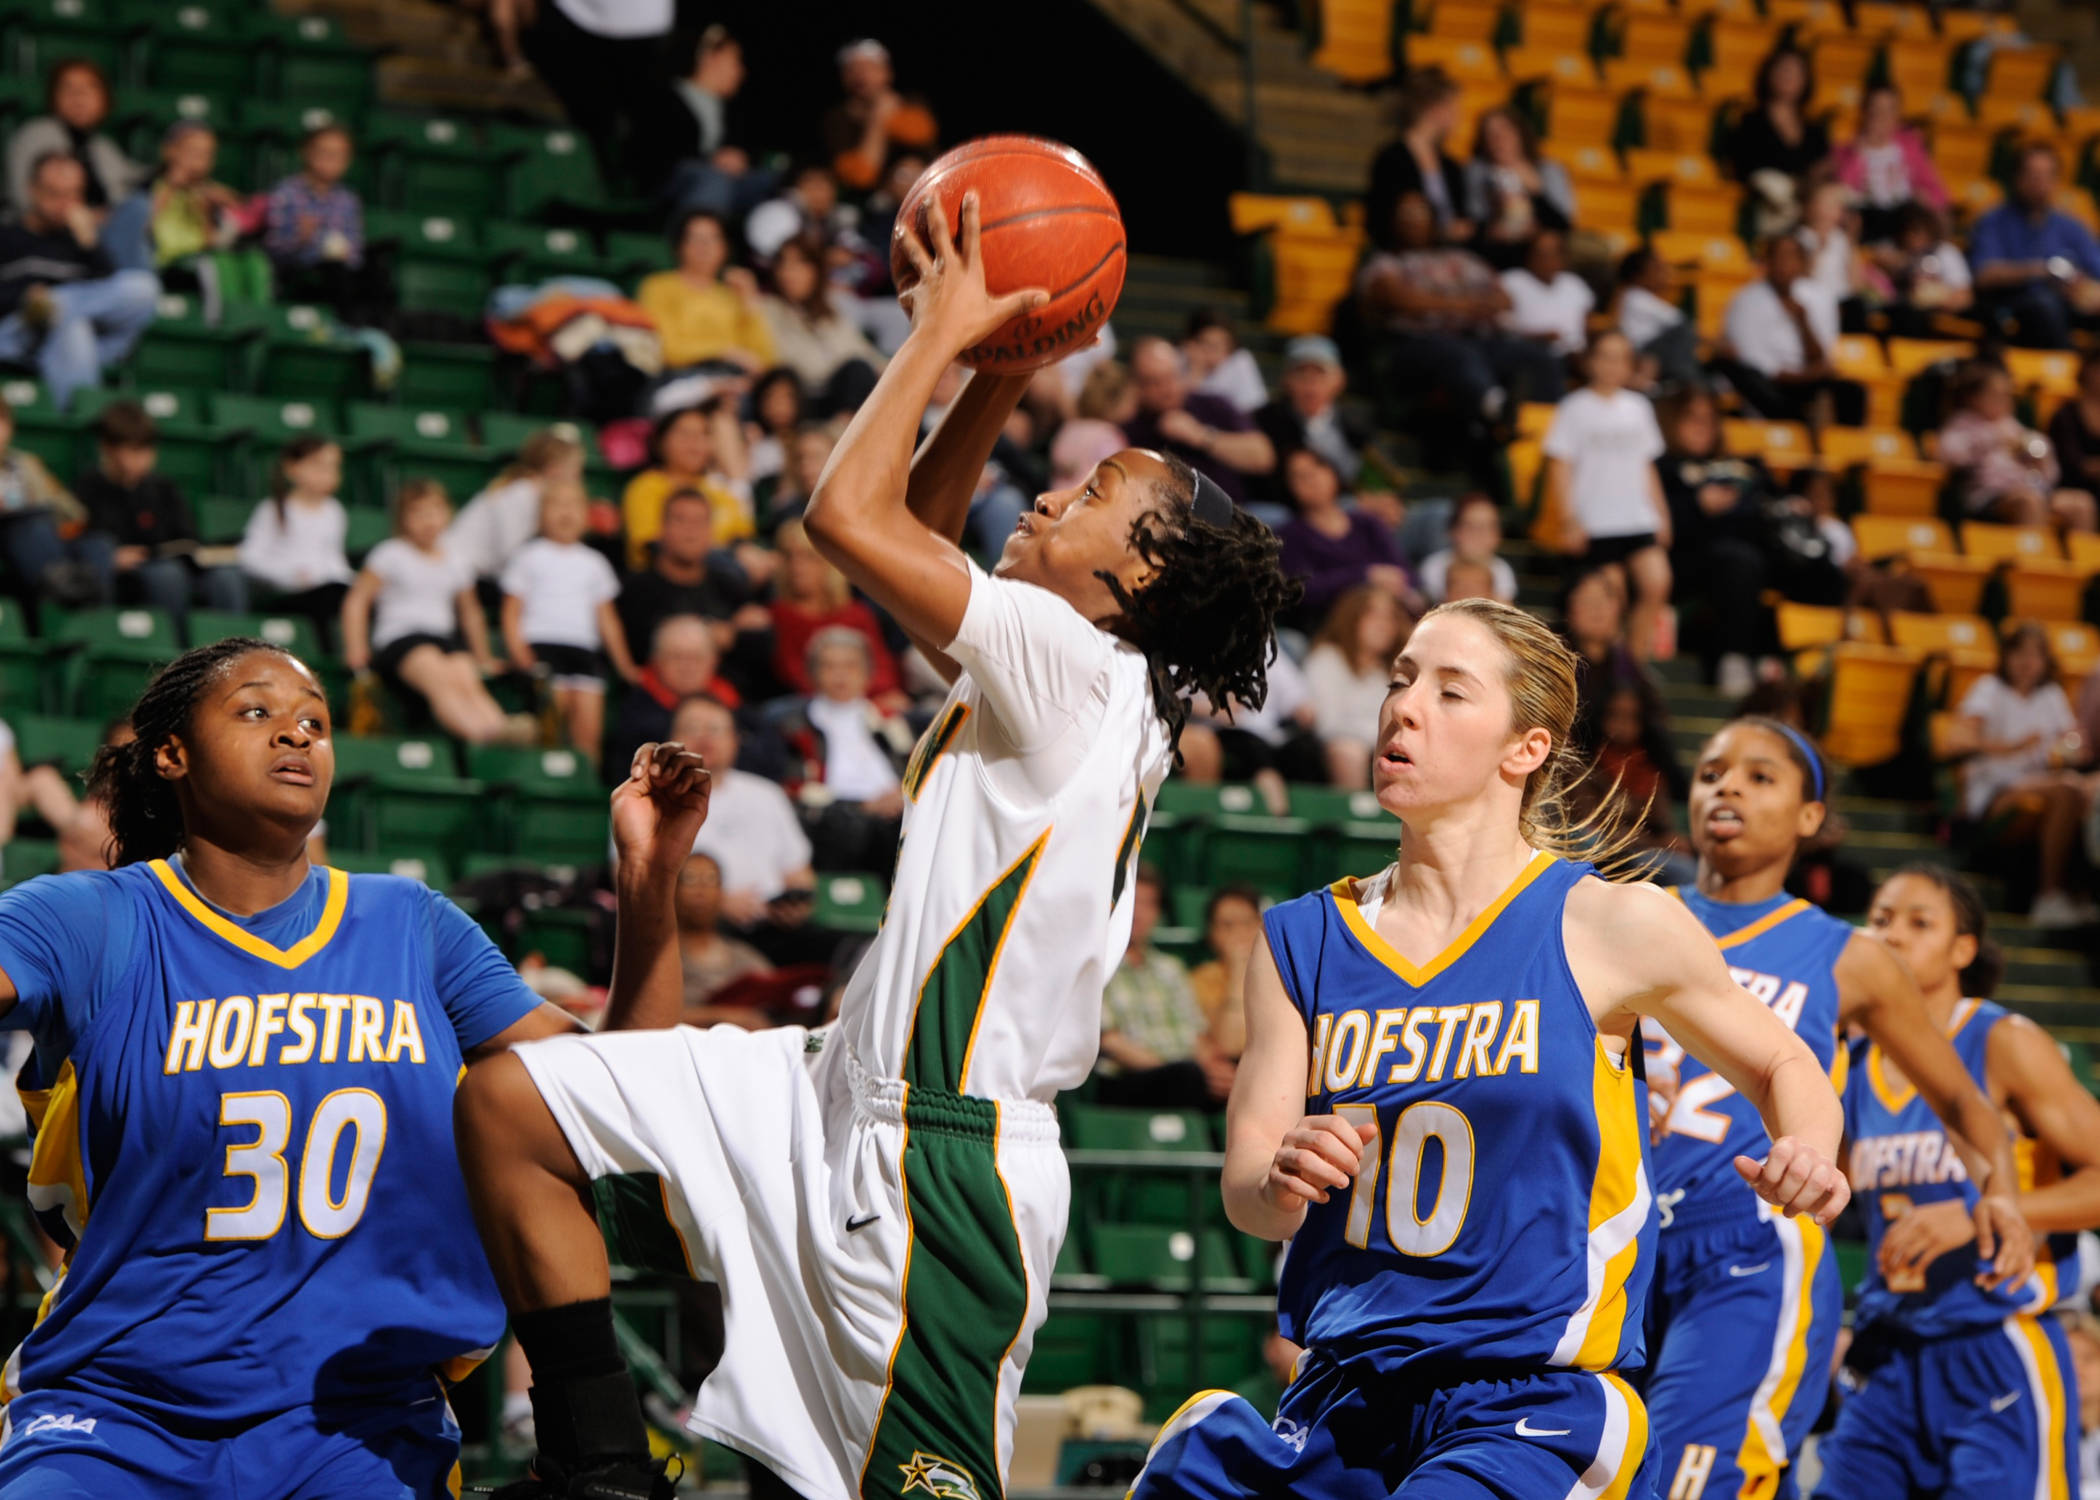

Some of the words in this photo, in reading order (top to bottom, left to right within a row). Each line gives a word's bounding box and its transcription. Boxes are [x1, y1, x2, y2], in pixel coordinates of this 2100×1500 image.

[164, 992, 427, 1076] HOFSTRA
[203, 1087, 388, 1242] 30
[1332, 1100, 1475, 1258] 10
[1849, 1129, 1969, 1193] OFSTRA
[24, 1413, 97, 1436] CAA
[1667, 1443, 1718, 1500] H
